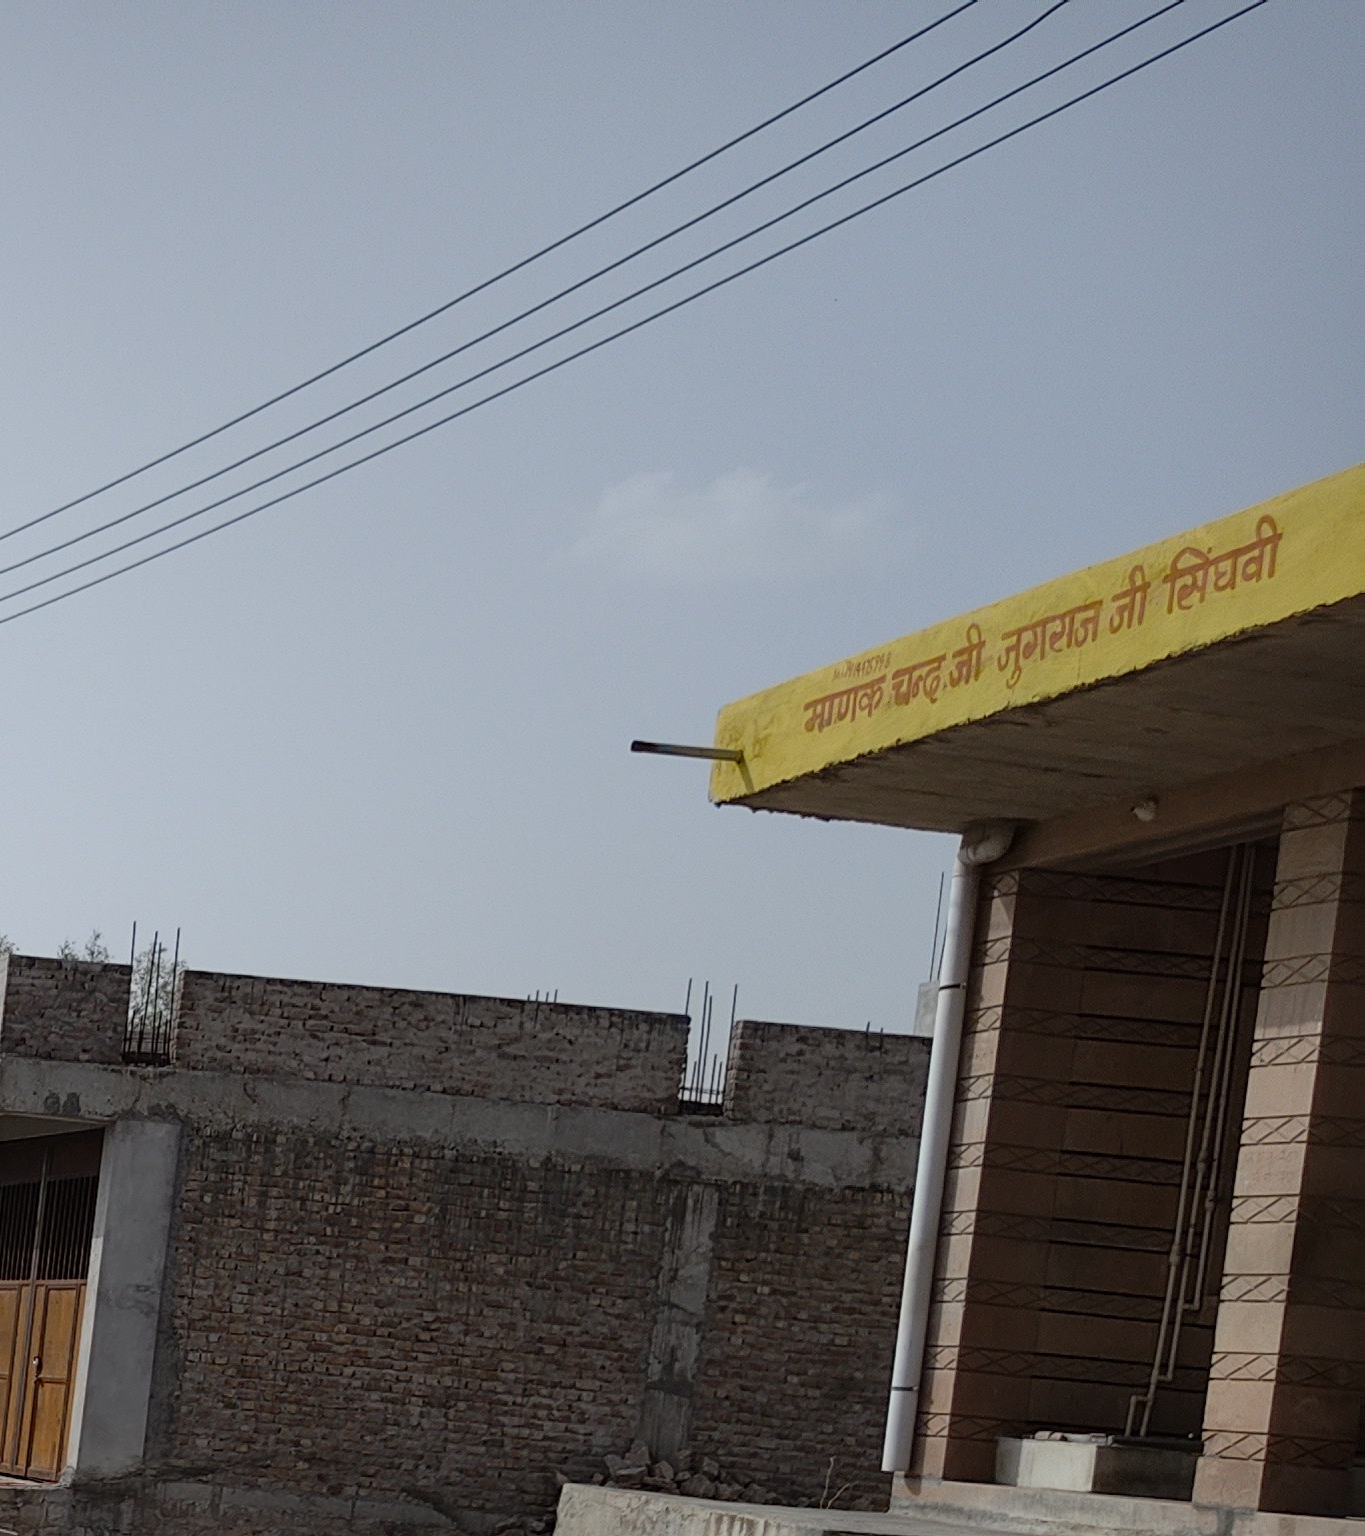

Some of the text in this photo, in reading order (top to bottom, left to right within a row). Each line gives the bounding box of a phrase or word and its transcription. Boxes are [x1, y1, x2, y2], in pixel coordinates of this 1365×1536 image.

[803, 674, 886, 733] माणक
[949, 623, 986, 688] जी
[997, 599, 1103, 690] जुगराज
[1109, 565, 1151, 634] जी
[1162, 514, 1283, 614] सिंघवी
